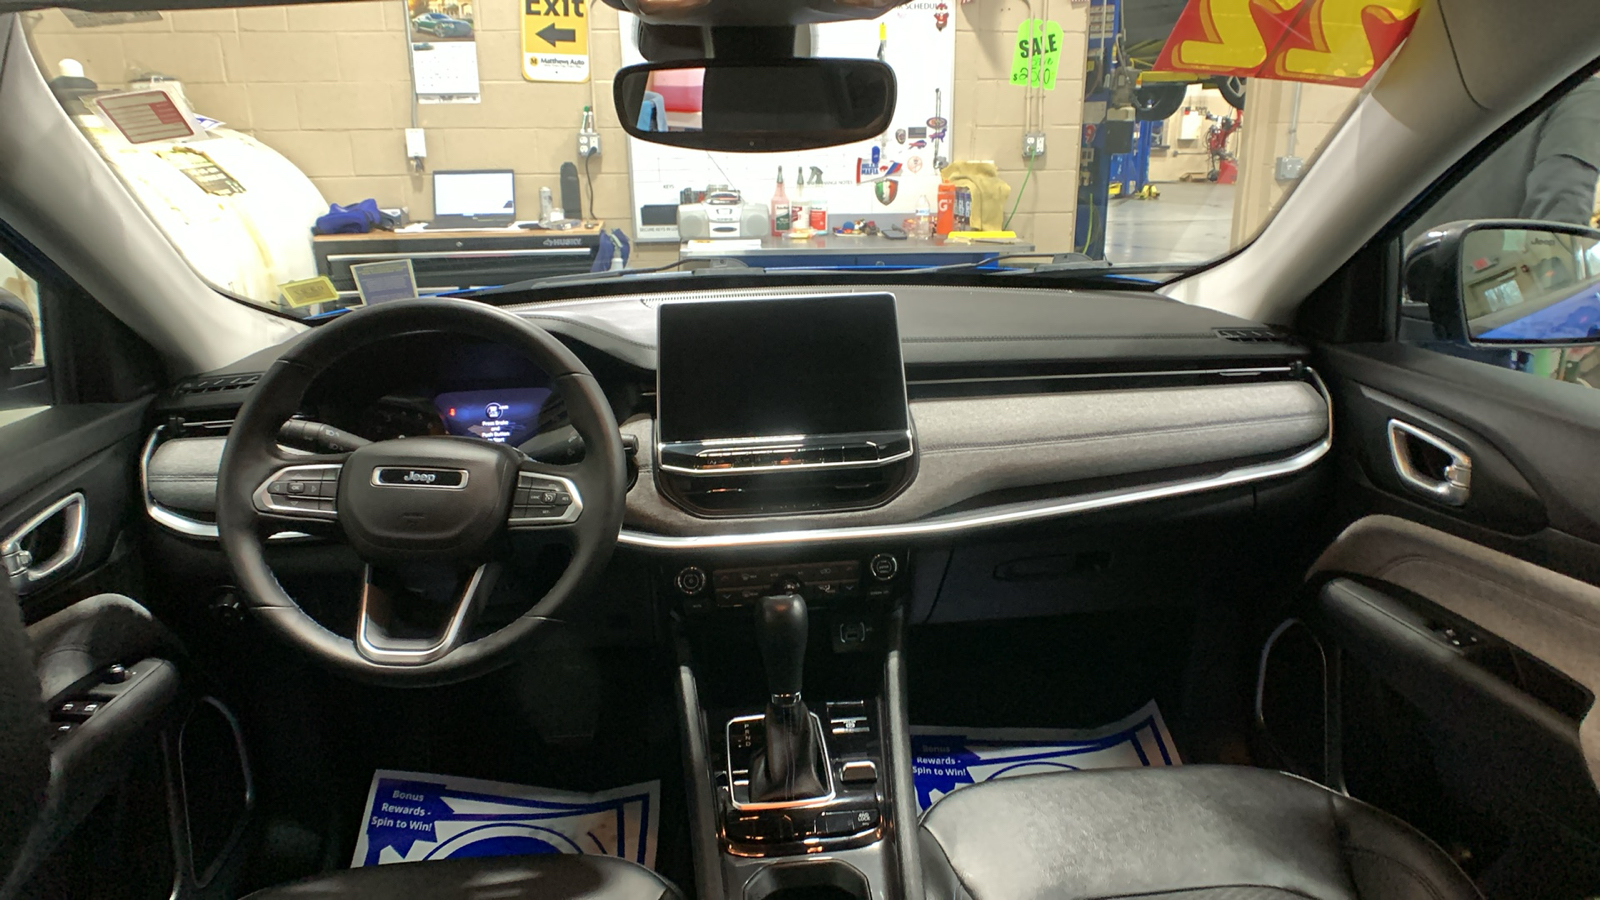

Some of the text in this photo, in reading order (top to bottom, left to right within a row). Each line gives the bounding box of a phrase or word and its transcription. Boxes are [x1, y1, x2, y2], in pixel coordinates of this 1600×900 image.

[525, 0, 585, 18] Exit
[1018, 33, 1058, 59] SALE
[552, 238, 582, 246] HUSKY
[403, 470, 437, 484] Jeep
[916, 756, 956, 765] Rewards
[912, 765, 967, 776] Spin to Win!
[392, 789, 425, 802] Bonus
[381, 802, 426, 817] Rewards
[371, 815, 433, 832] Spin to Win!
